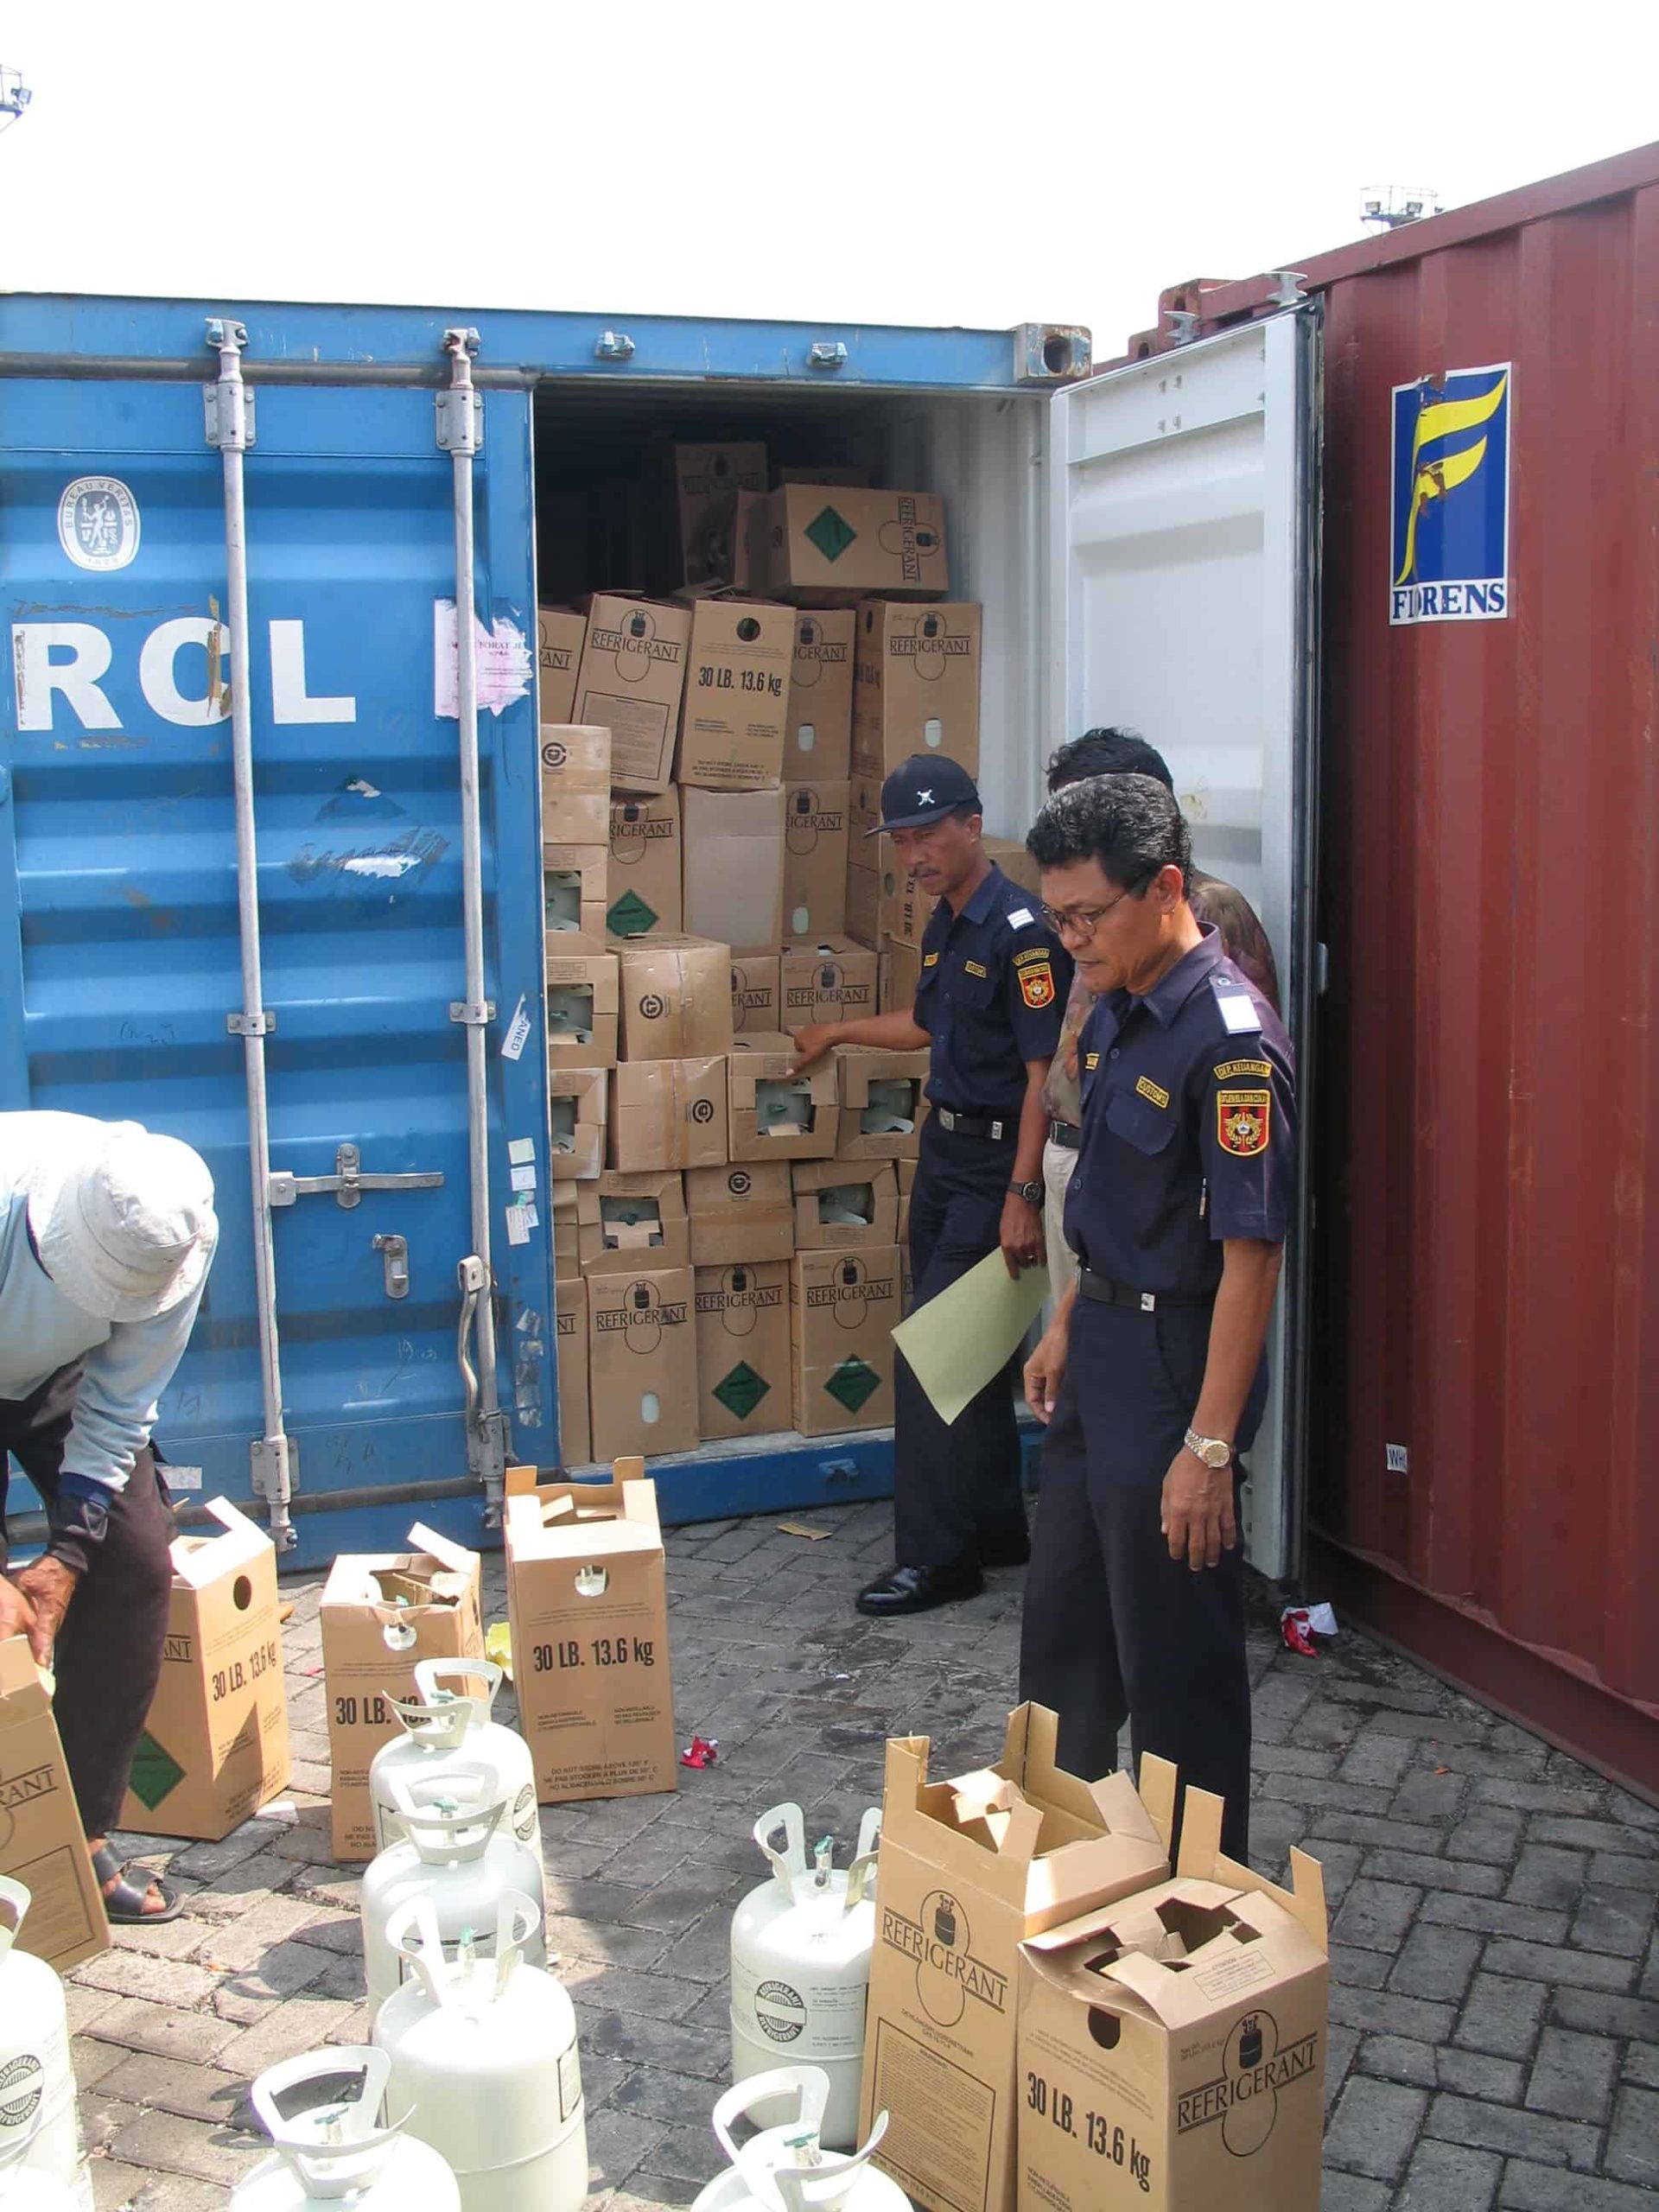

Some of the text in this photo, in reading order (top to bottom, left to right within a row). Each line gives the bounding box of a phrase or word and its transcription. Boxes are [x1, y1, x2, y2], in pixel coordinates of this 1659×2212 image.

[66, 482, 132, 529] BUREAU VERITAS
[900, 496, 917, 581] REFRIGERANT
[590, 632, 681, 661] REFRIGERANT
[890, 639, 970, 653] REFRIGERANT
[12, 617, 357, 731] RCL
[698, 667, 783, 697] 30 LB. 13.6 kg
[786, 988, 870, 1005] REFRIGERANT
[695, 1289, 783, 1309] REFRIGERANT
[806, 1282, 893, 1304] REFRIGERANT
[596, 1306, 688, 1328] REFRIGERANT
[533, 1637, 654, 1672] 30 LB. 13.6 kg
[212, 1641, 277, 1701] 30 LB. 13.6 kg
[335, 1696, 357, 1725] 30
[363, 1697, 391, 1725] LB.
[882, 1912, 1008, 2006] REFRIGERANT
[1178, 2039, 1318, 2127] REFRIGERANT
[1027, 2071, 1046, 2116] 30
[1052, 2088, 1077, 2139] LB.
[1085, 2111, 1124, 2166] 13.6
[1130, 2137, 1151, 2193] kg
